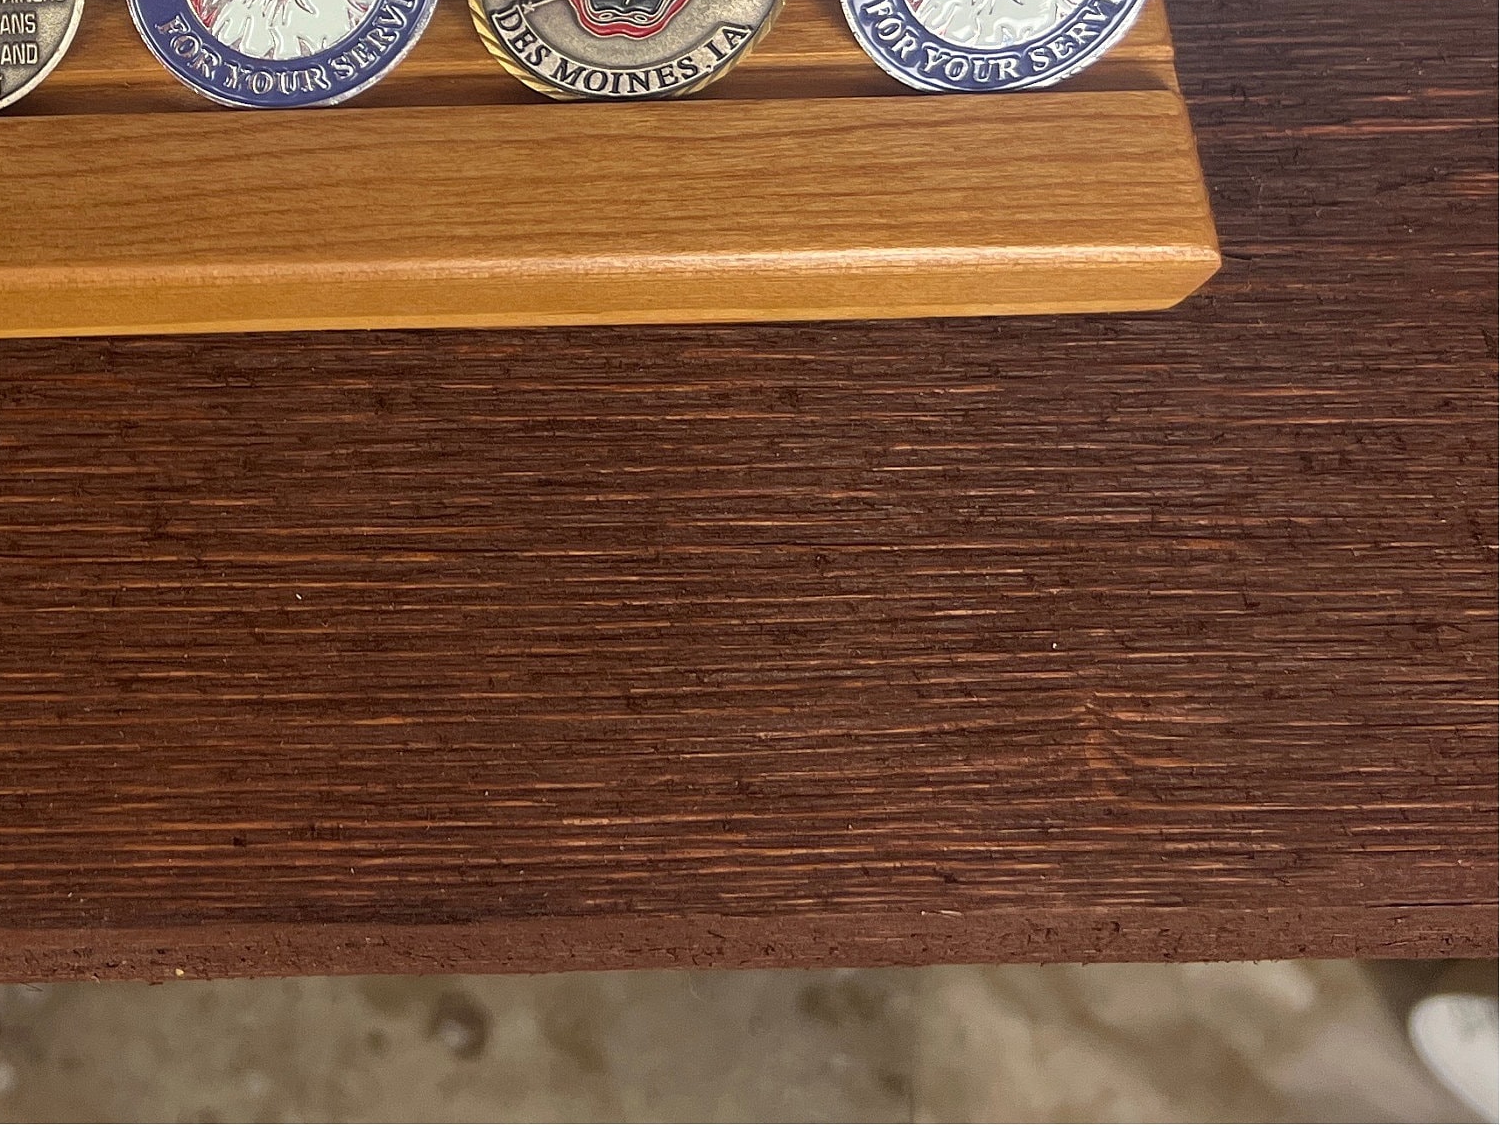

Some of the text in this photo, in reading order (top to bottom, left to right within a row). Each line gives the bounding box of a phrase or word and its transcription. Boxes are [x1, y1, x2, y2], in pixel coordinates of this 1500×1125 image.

[0, 43, 38, 65] AND
[155, 15, 223, 72] FOR
[223, 61, 332, 95] YOUR
[492, 7, 551, 66] DES
[707, 25, 751, 63] IA
[920, 46, 1021, 83] YOUR
